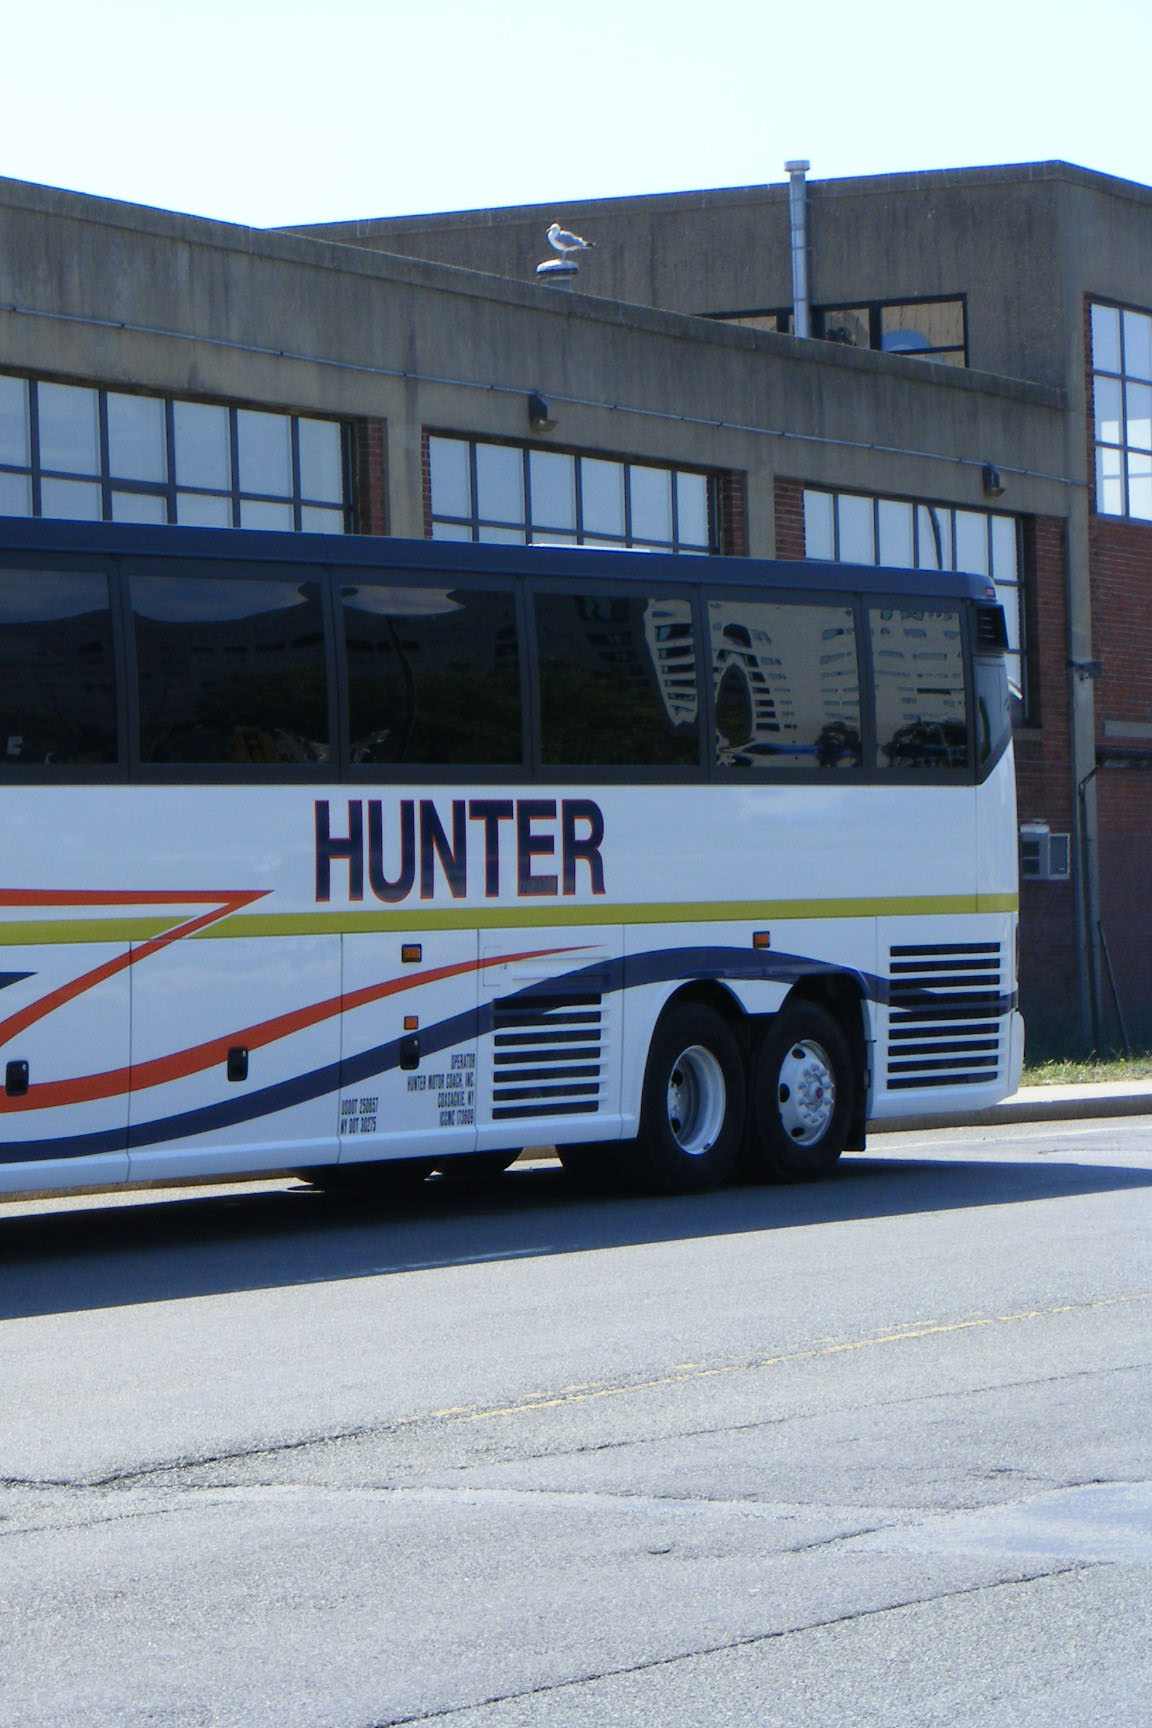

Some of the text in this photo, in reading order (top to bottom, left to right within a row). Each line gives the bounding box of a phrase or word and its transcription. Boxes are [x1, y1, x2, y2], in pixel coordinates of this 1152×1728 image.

[314, 799, 606, 903] HUNTER
[451, 1053, 476, 1070] OPERATOR
[407, 1075, 427, 1092] HUNTER
[428, 1073, 445, 1090] MOTOR
[341, 1098, 358, 1115] USDOT
[349, 1117, 359, 1134] DOT
